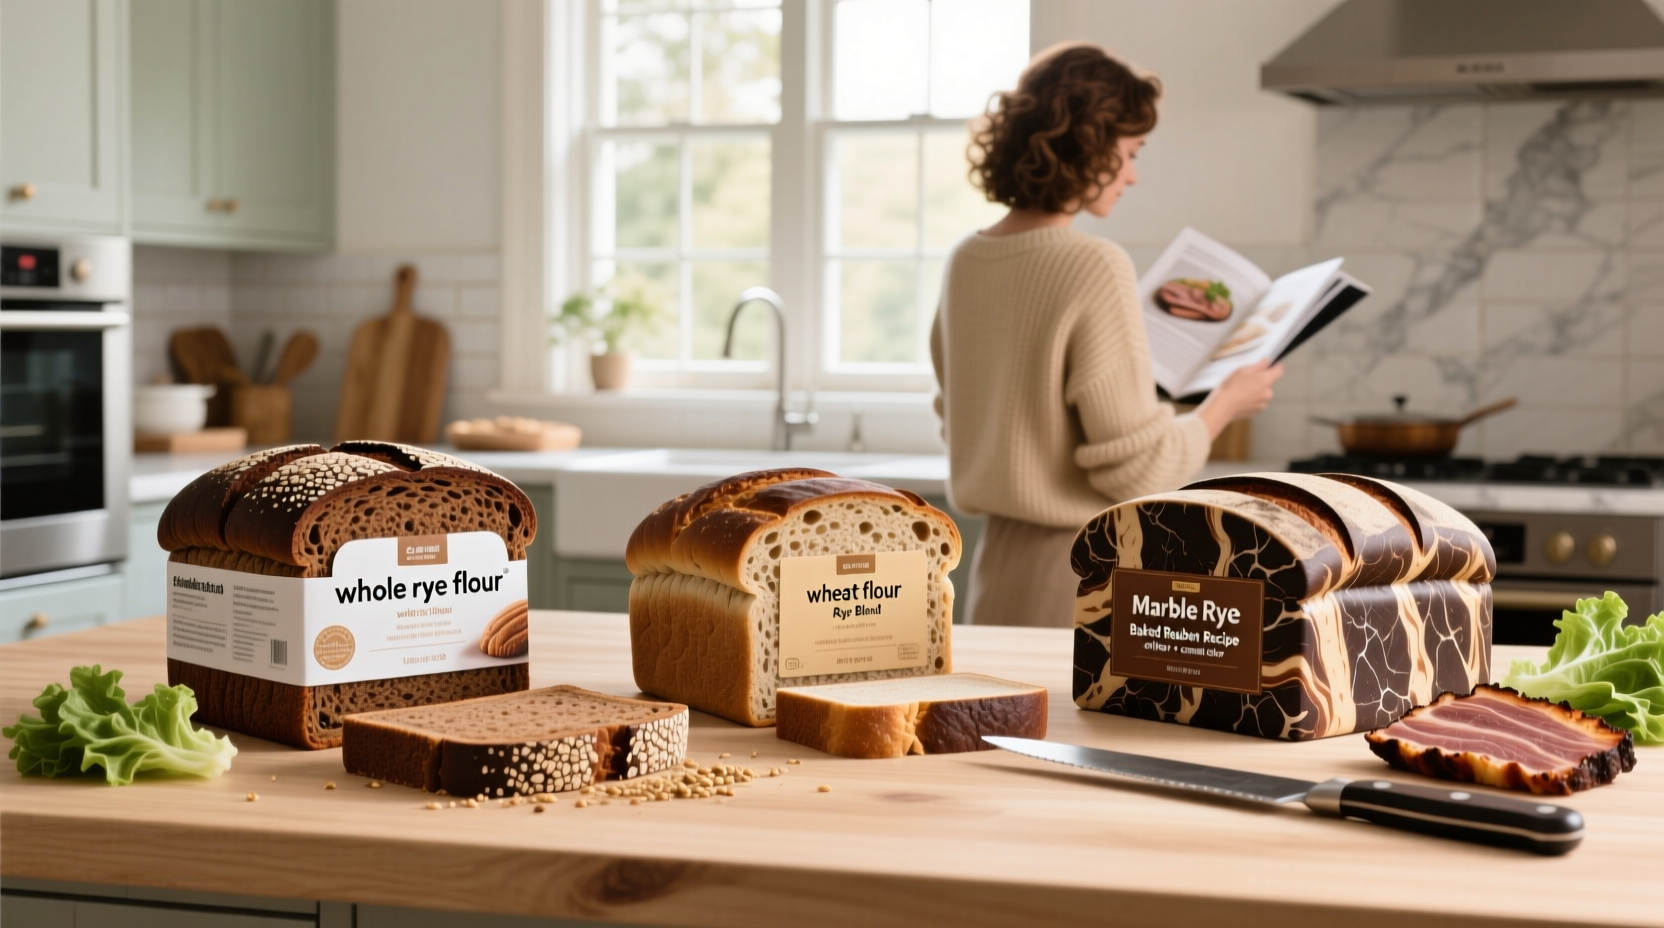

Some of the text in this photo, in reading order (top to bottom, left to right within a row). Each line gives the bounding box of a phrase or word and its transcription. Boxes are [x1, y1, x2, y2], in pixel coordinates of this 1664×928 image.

[335, 570, 504, 604] whole rye flour
[806, 580, 902, 603] wheat flour
[832, 606, 852, 621] Rye
[1132, 594, 1241, 629] Marble Rye
